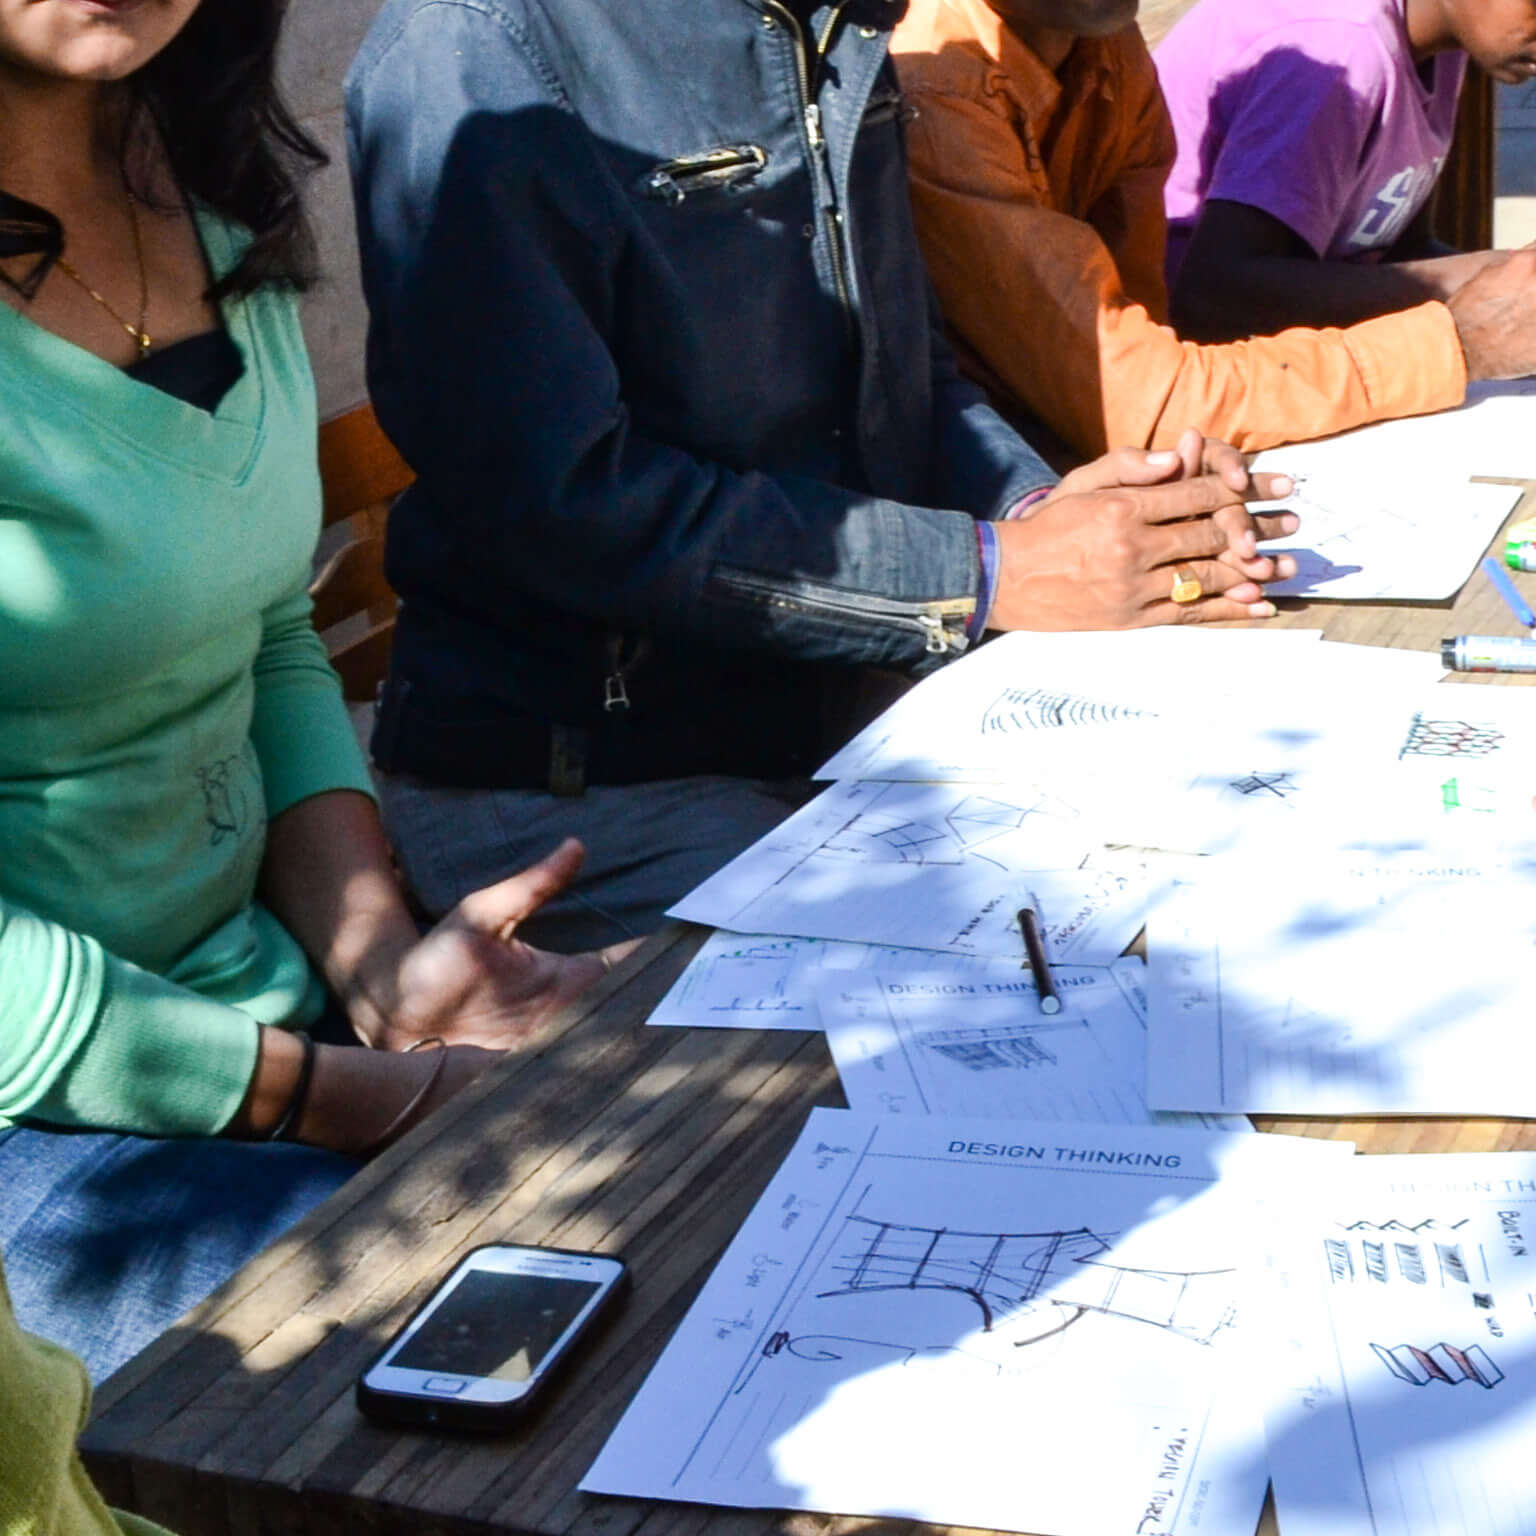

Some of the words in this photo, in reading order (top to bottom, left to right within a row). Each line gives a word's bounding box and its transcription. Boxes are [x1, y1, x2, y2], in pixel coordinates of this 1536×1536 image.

[888, 982, 976, 995] DESIGN
[983, 974, 1097, 995] THINING
[947, 1140, 1046, 1160] DESIGN
[1055, 1146, 1183, 1169] THINKING
